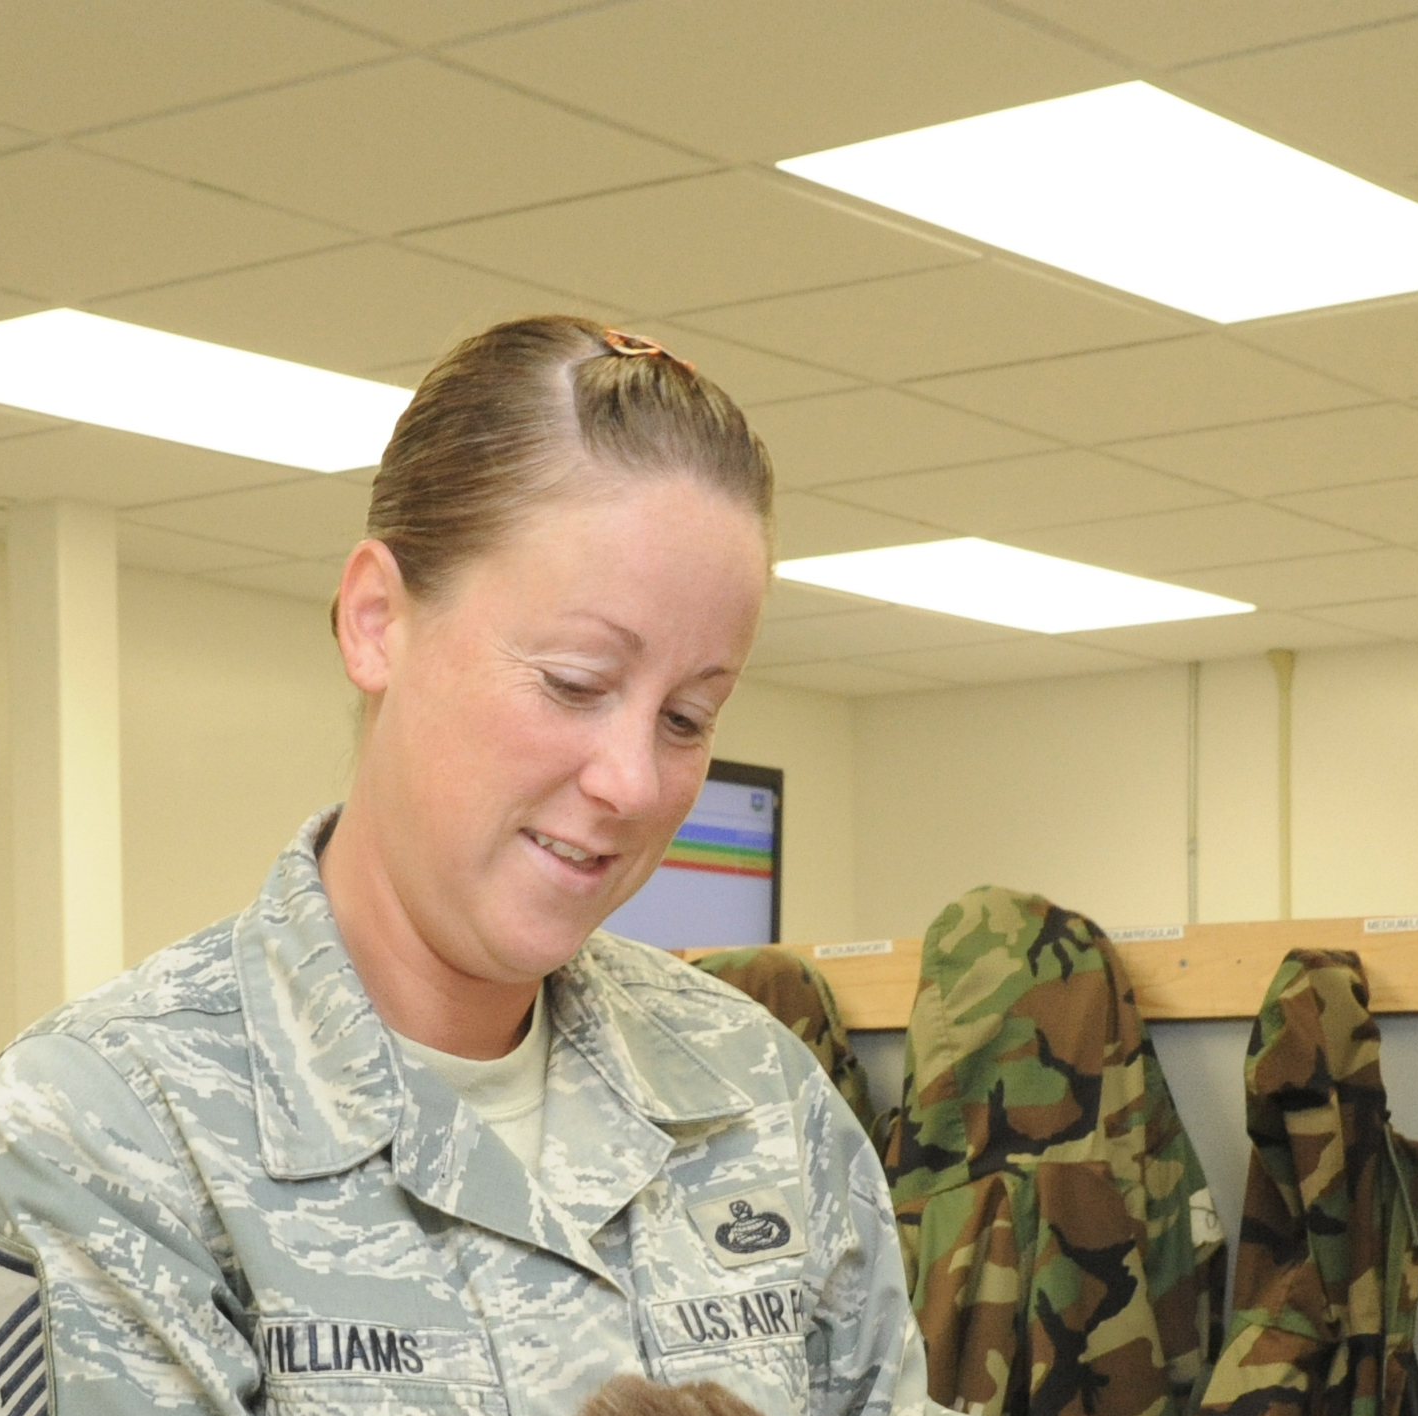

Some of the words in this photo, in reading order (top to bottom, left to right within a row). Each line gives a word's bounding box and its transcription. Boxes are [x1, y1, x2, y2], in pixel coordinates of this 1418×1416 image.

[675, 1300, 738, 1343] U.S.
[739, 1289, 790, 1338] AIR
[265, 1323, 424, 1374] ILLIAMS
